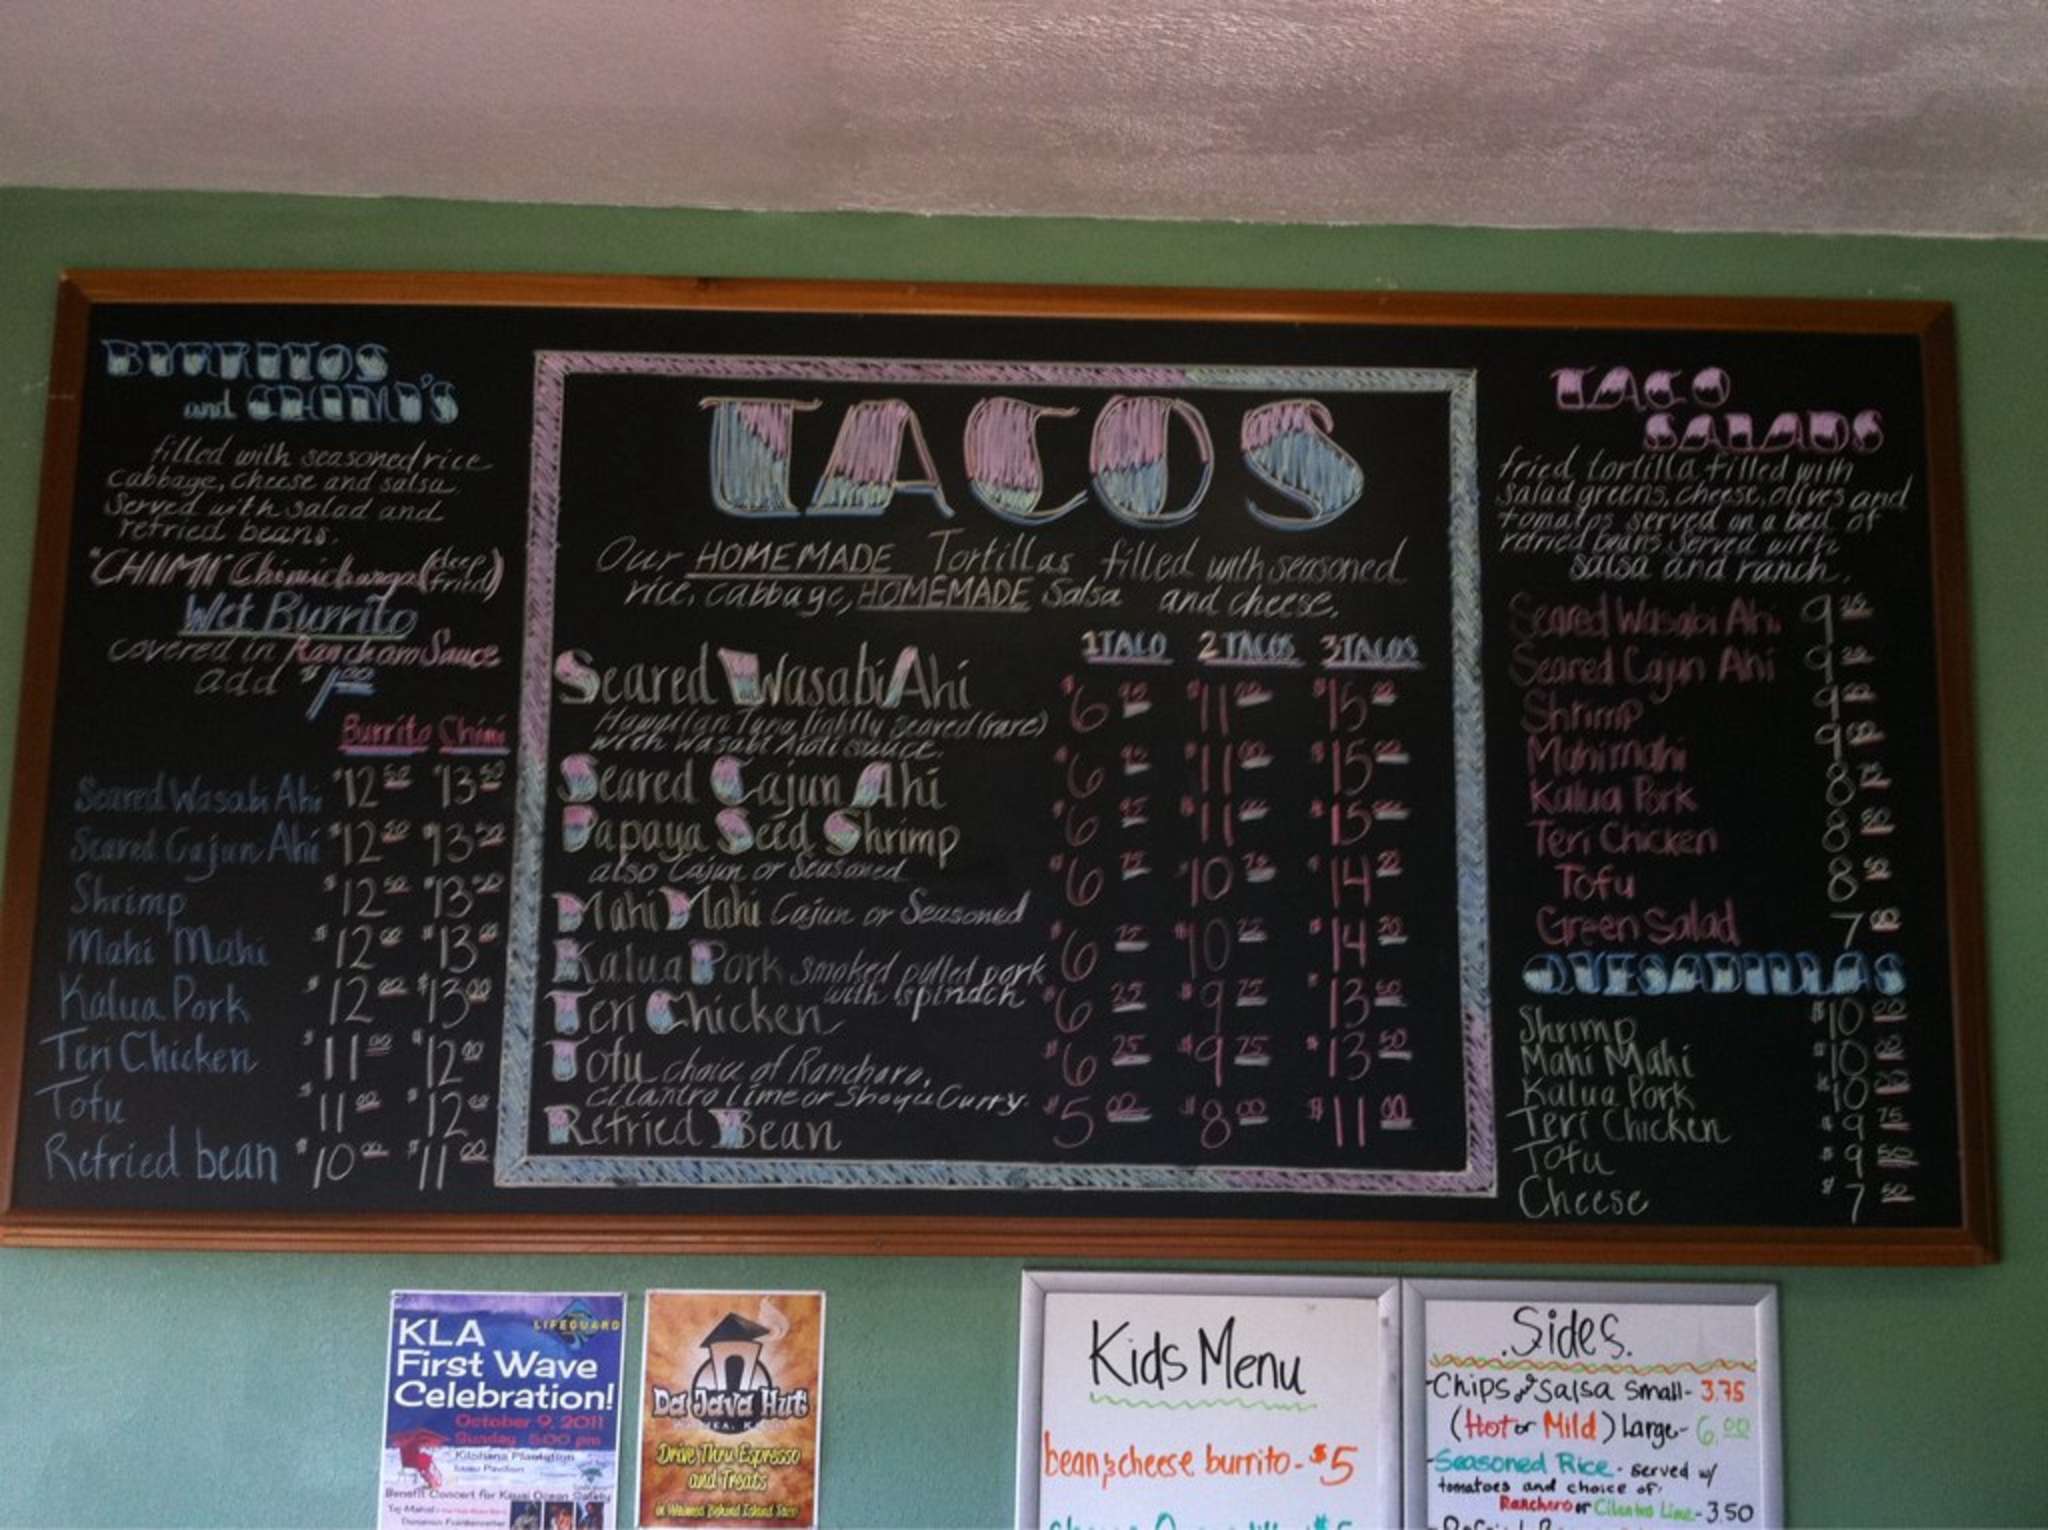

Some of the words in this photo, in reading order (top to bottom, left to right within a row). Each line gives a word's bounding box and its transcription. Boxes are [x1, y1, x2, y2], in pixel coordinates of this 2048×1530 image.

[183, 388, 238, 420] and
[1550, 366, 1730, 411] TACO
[1643, 409, 1884, 453] SALADS
[152, 433, 235, 467] filled
[234, 441, 290, 467] with
[300, 440, 427, 475] seasoned
[421, 449, 494, 471] rice
[699, 394, 1364, 531] TACOS
[230, 469, 317, 491] cheese
[322, 469, 377, 491] and
[1848, 473, 1913, 512] and
[207, 495, 280, 518] with
[377, 499, 445, 522] and
[595, 535, 685, 573] Our
[694, 540, 893, 574] HOMEMADE
[1102, 538, 1196, 583] filled
[1206, 547, 1264, 581] with
[1661, 553, 1729, 581] and
[184, 590, 254, 635] Wet
[262, 583, 418, 636] Burrito
[860, 576, 1032, 606] HOMEMADE
[1160, 586, 1224, 613] and
[107, 636, 238, 664] covered
[241, 640, 275, 665] in
[194, 667, 275, 696] add
[554, 641, 718, 704] Seared
[717, 641, 884, 706] Wasabi
[880, 645, 970, 709] Ahi
[557, 753, 700, 804] Seared
[710, 755, 841, 818] Cajun
[852, 759, 948, 810] Ahi
[561, 803, 709, 864] Papaya
[715, 806, 816, 856] Seed
[823, 806, 961, 868] Shrimp
[1529, 819, 1590, 856] Teri
[1602, 821, 1718, 857] Chicken
[1555, 863, 1636, 901] Tofu
[771, 891, 855, 930] Cajun
[862, 905, 895, 928] or
[1536, 904, 1642, 946] Green
[1645, 901, 1740, 946] Salad
[552, 937, 684, 985] Kalua
[688, 935, 785, 986] Pork
[174, 974, 252, 1024] Pork
[544, 983, 637, 1036] Teri
[646, 986, 846, 1036] Chicken
[1519, 1004, 1637, 1048] Shrimp
[38, 1026, 110, 1072] Teri
[120, 1029, 259, 1073] Chicken
[543, 1036, 660, 1083] Tofu
[1519, 1042, 1595, 1078] Mahi
[1604, 1039, 1697, 1078] Mahi
[34, 1075, 125, 1125] Tofu
[1522, 1078, 1619, 1108] Kalua
[1626, 1078, 1697, 1111] Pork
[543, 1104, 702, 1147] Refried
[708, 1108, 842, 1151] Bean
[1507, 1105, 1590, 1141] Teri
[1602, 1109, 1730, 1145] Chicken
[44, 1124, 180, 1182] Refried
[196, 1126, 279, 1184] bean
[1514, 1136, 1614, 1176] Tofu
[1519, 1175, 1651, 1219] Cheese
[399, 1318, 486, 1348] KLA
[397, 1351, 483, 1378] First
[494, 1350, 598, 1380] Wave
[1089, 1319, 1188, 1391] Kids
[1199, 1316, 1306, 1396] Menu
[394, 1380, 616, 1412] Celebration!
[652, 1386, 688, 1418] Da
[692, 1387, 755, 1418] Java
[760, 1385, 811, 1418] Hut
[1700, 1379, 1746, 1403] 3.75
[455, 1413, 530, 1429] October
[562, 1414, 604, 1430] 2011
[1514, 1421, 1537, 1436] or
[736, 1441, 801, 1470] Espresso
[1556, 1453, 1615, 1478] Rice
[687, 1470, 717, 1491] and
[719, 1468, 769, 1491] Treats
[1438, 1478, 1511, 1494] tomatoes
[1522, 1478, 1557, 1493] and
[1567, 1478, 1628, 1495] choice
[1500, 1496, 1574, 1512] Ranchero
[1575, 1500, 1593, 1516] or
[1705, 1501, 1756, 1524] 3.50
